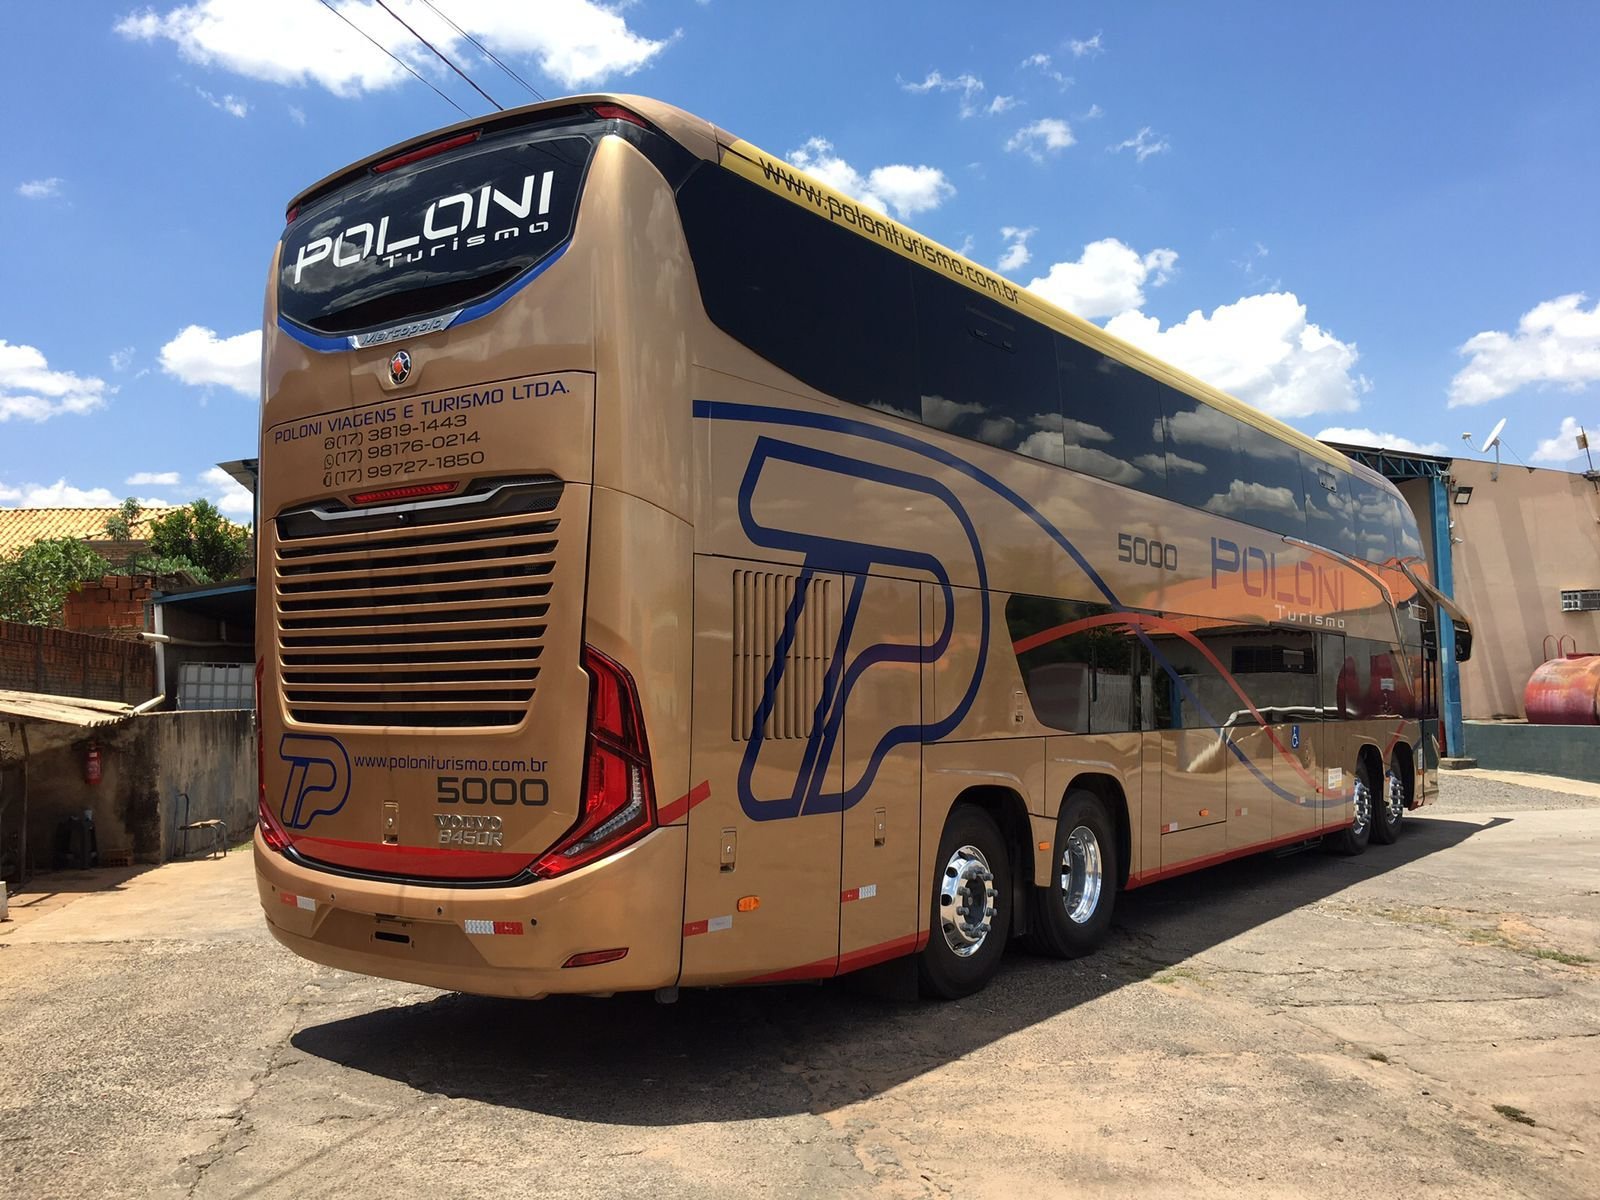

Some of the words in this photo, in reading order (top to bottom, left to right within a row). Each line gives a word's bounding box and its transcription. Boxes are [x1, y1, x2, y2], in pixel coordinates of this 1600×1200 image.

[294, 170, 554, 285] POLONI
[382, 220, 549, 268] Turismo
[759, 156, 1019, 305] www.poloniturismo.com.br
[361, 318, 443, 345] Marcopolo
[274, 421, 322, 445] POLONI
[327, 407, 396, 433] VIAGENS
[403, 404, 414, 419] E
[422, 389, 504, 415] TURISMO
[512, 379, 570, 399] LTDA.
[335, 448, 363, 467] (17)
[367, 430, 481, 460] 98176-0214
[336, 431, 364, 449] (17)
[367, 414, 467, 442] 3819-1443
[335, 468, 363, 486] (17)
[367, 450, 485, 479] 99727-1850
[1118, 533, 1178, 572] 5000
[1211, 536, 1345, 612] POLONI
[1274, 604, 1345, 629] Turismo
[353, 753, 548, 772] www.poloniturismo.com.br
[437, 776, 549, 806] 5000
[433, 814, 503, 830] VOLVO
[438, 829, 503, 847] B450R
